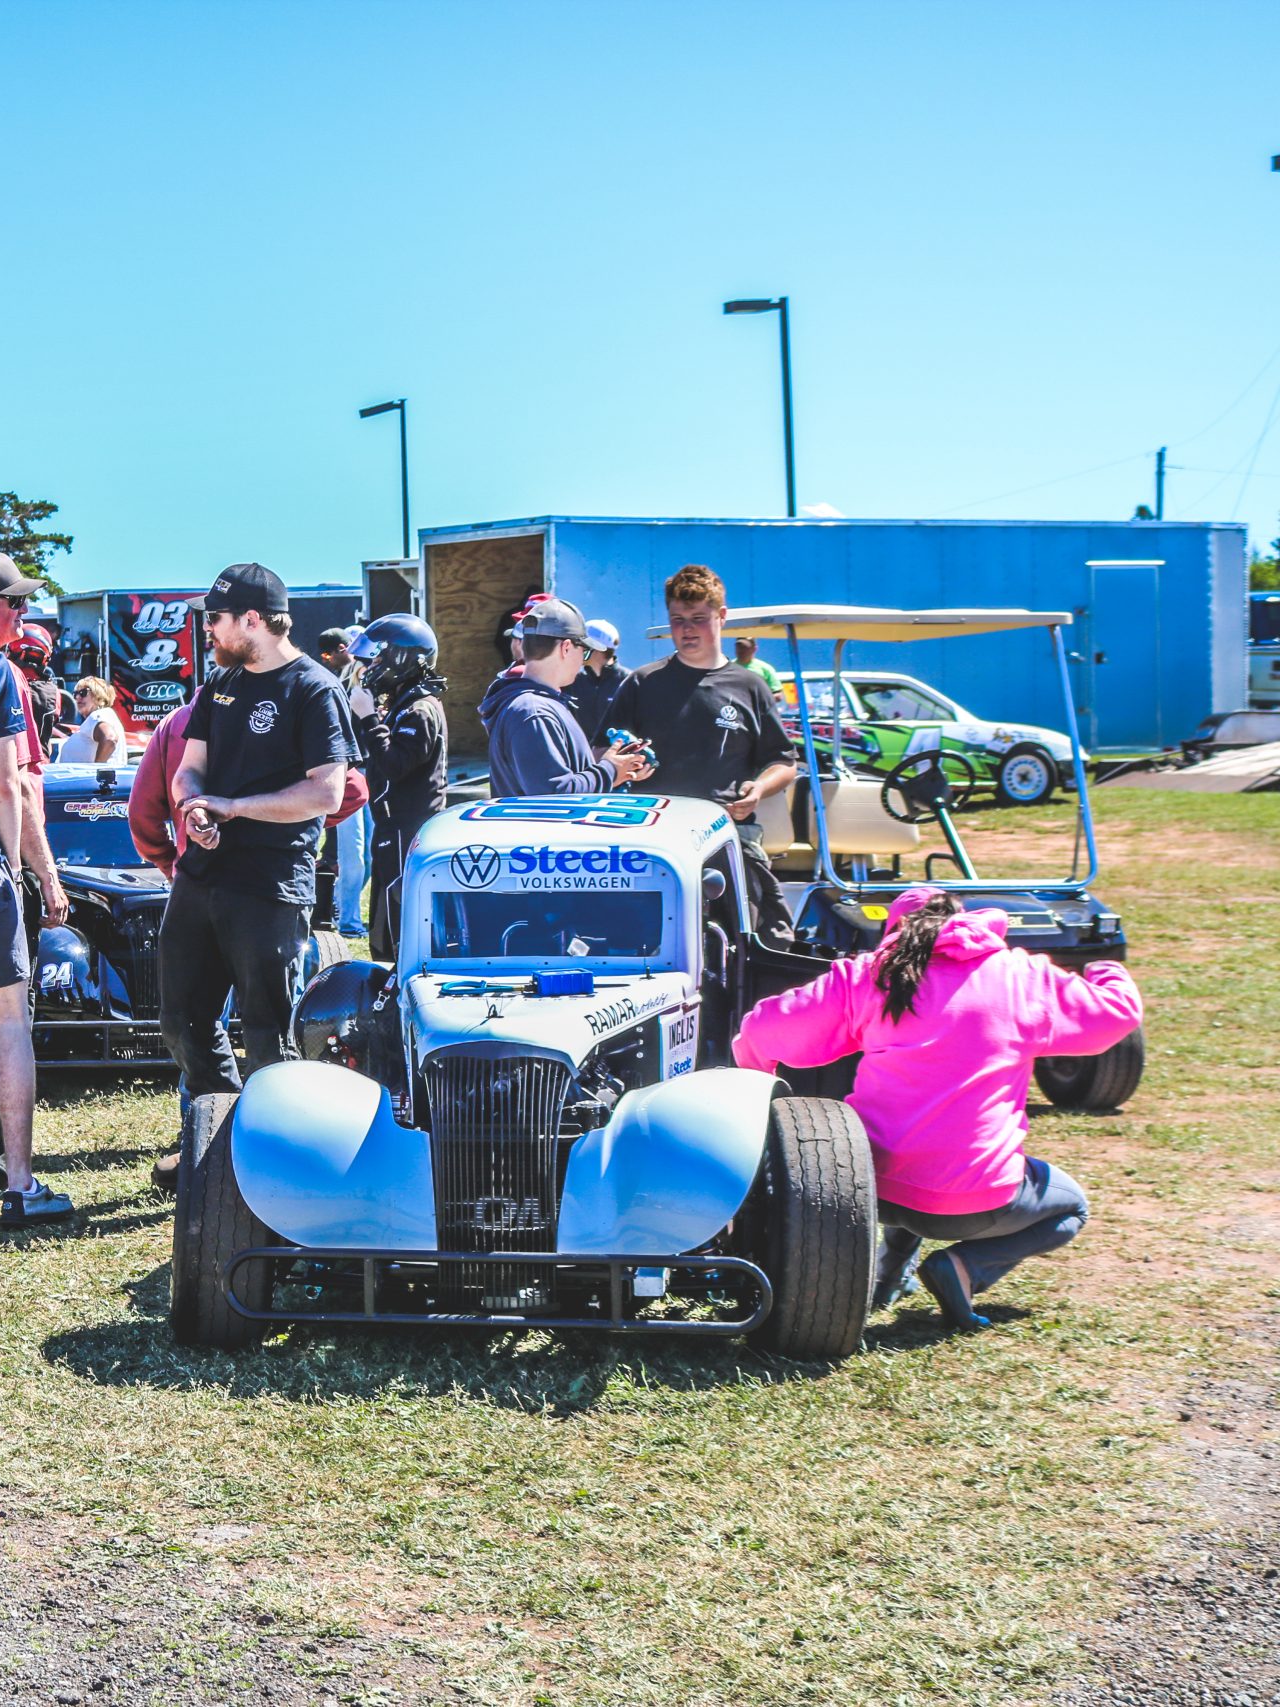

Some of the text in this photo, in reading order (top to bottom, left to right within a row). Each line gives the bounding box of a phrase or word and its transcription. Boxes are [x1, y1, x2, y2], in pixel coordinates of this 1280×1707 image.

[137, 600, 189, 633] 03
[142, 638, 178, 670] 8
[146, 685, 176, 698] ECC
[67, 803, 104, 811] CROSS
[508, 845, 648, 874] Steele
[520, 877, 631, 889] VOLKSWAGEN
[41, 961, 73, 988] 24
[584, 998, 637, 1037] RAMAR
[668, 1015, 695, 1051] INGLIS
